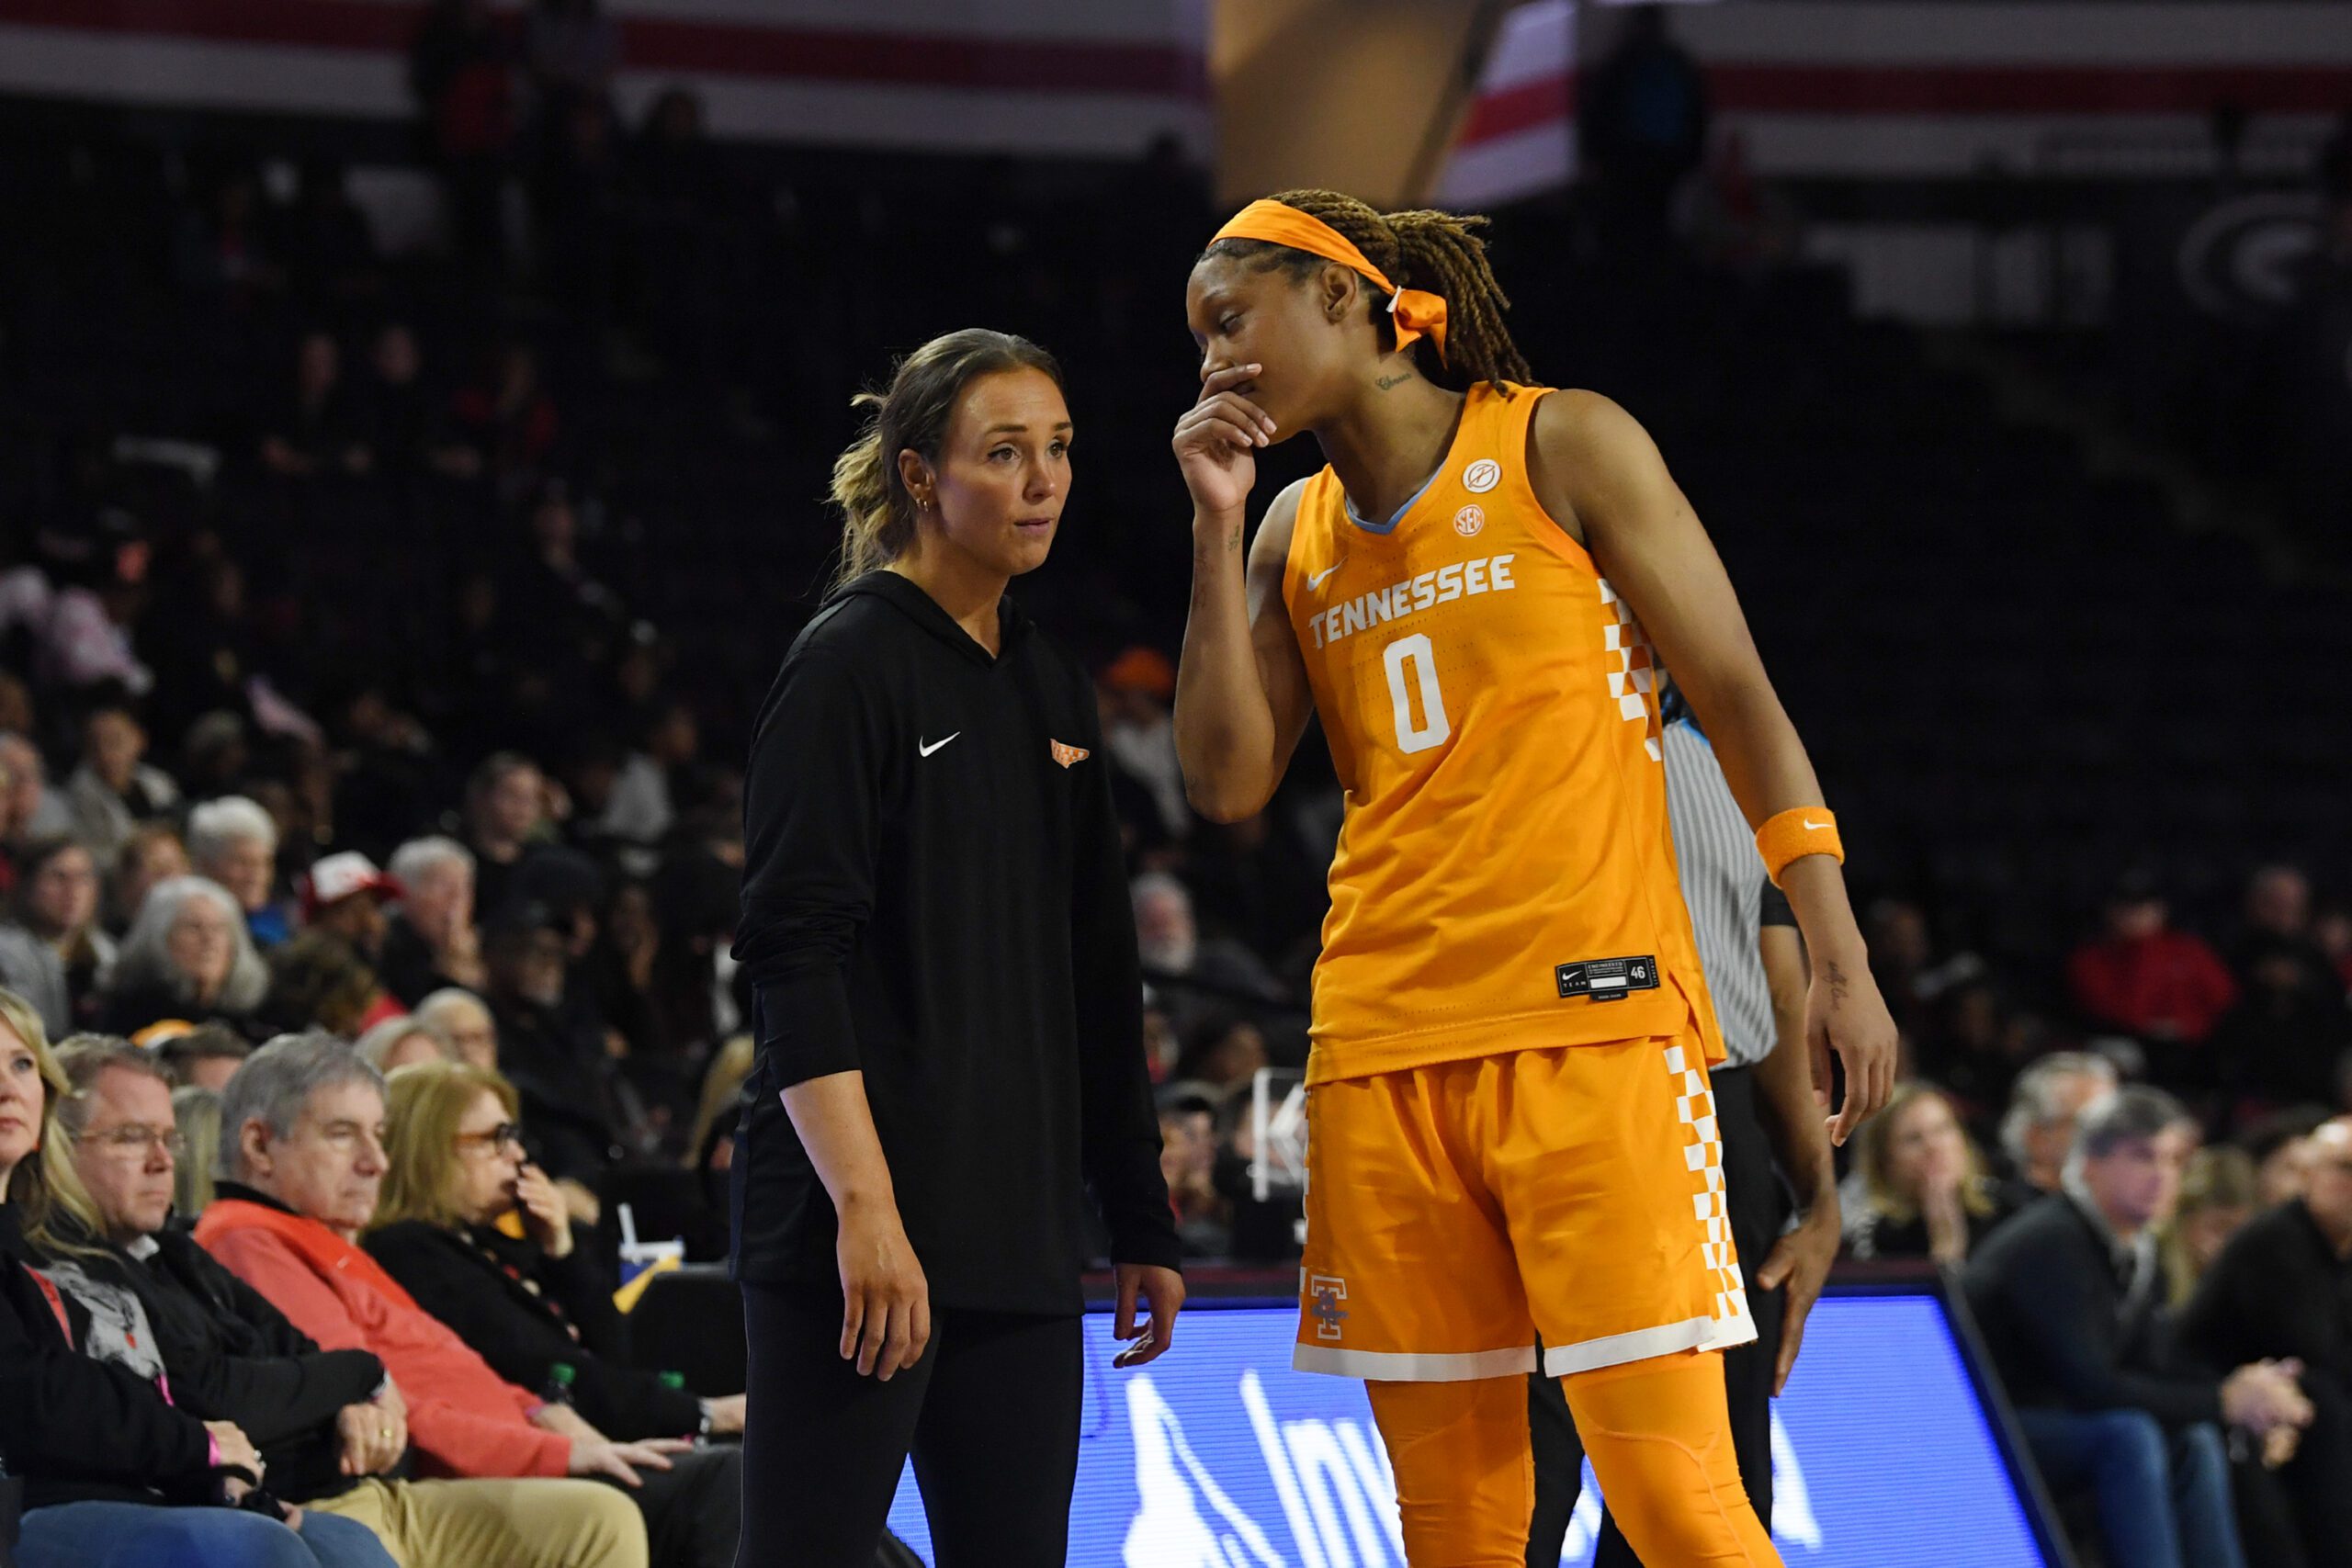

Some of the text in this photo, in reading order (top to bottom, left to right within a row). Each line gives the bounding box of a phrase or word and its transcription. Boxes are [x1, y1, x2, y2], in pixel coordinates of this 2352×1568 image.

[1456, 507, 1483, 534] SEC
[1308, 554, 1515, 649] TENNESSEE
[1383, 633, 1451, 754] 0
[1631, 965, 1645, 979] 46
